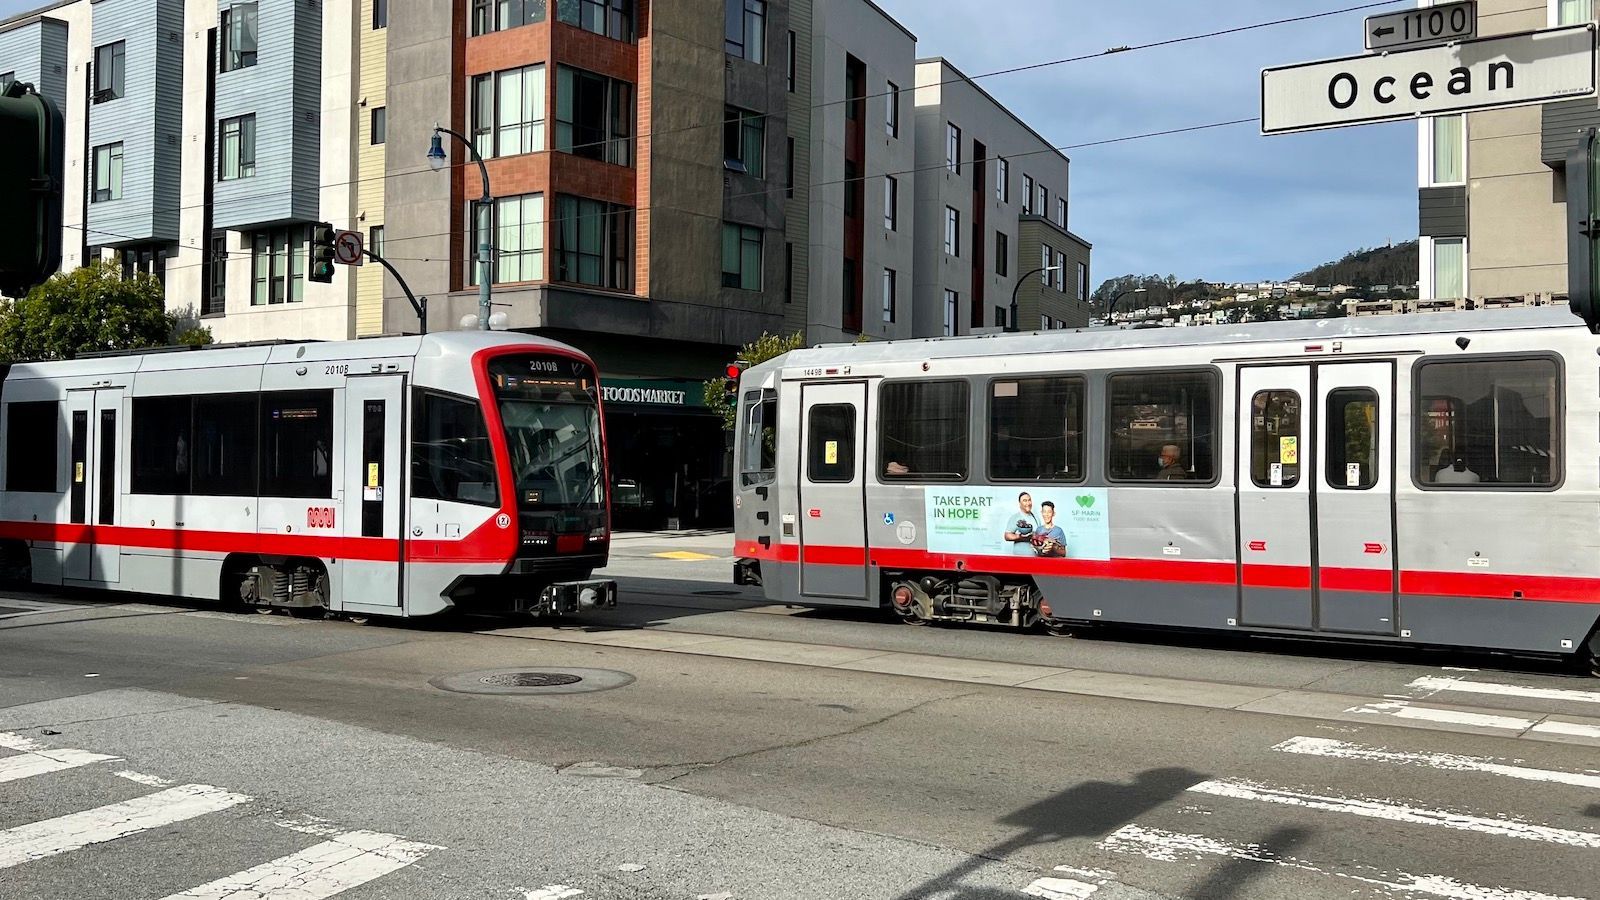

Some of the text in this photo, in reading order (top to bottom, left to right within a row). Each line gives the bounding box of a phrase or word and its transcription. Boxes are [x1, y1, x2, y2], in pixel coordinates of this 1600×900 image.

[1403, 7, 1466, 40] 1100
[1328, 60, 1514, 110] Ocean
[325, 364, 349, 375] 2010B
[603, 386, 640, 402] FOODS
[640, 388, 686, 404] MARKET
[933, 495, 994, 507] TAKE PART
[933, 508, 979, 519] IN HOPE
